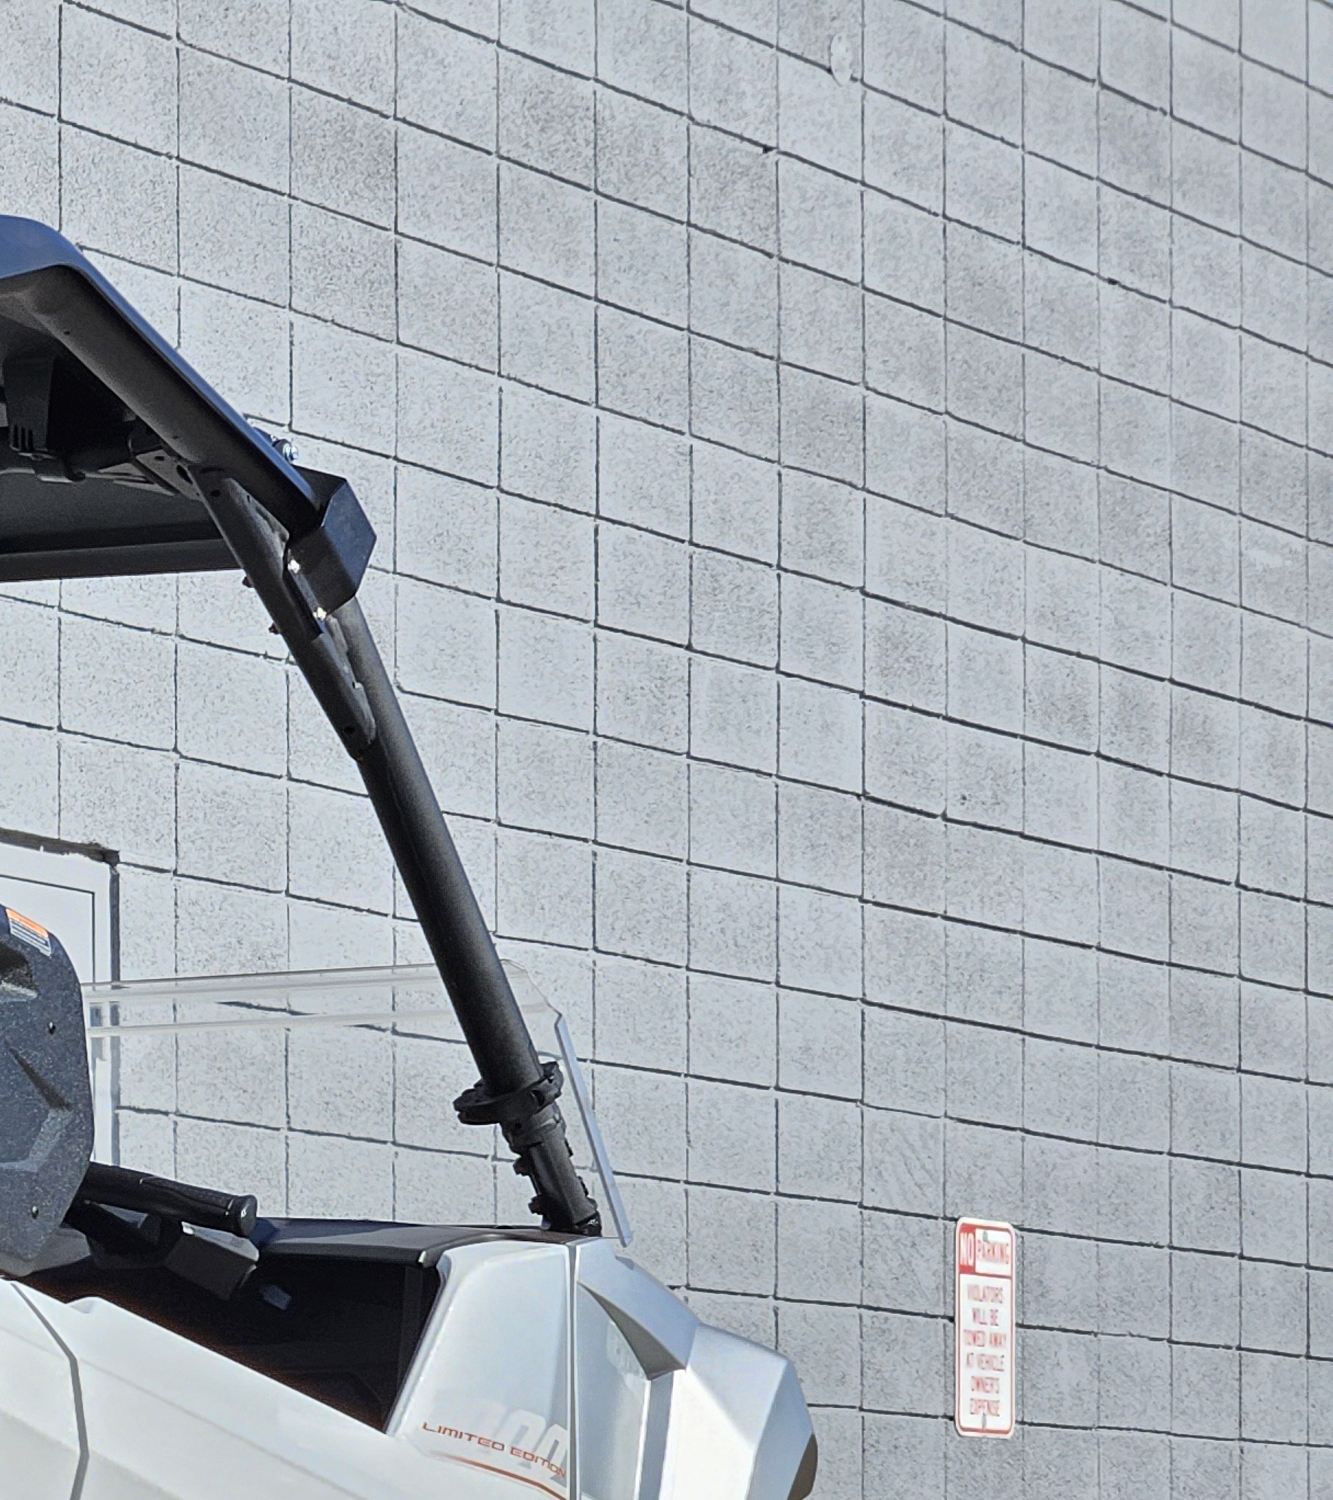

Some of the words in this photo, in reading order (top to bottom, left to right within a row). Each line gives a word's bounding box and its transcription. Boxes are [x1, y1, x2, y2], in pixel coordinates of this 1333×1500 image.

[959, 1232, 974, 1267] NO
[977, 1239, 1010, 1266] PARKING
[963, 1329, 986, 1347] TOWED
[422, 1421, 505, 1452] LIMITED
[509, 1446, 567, 1479] EDITION
